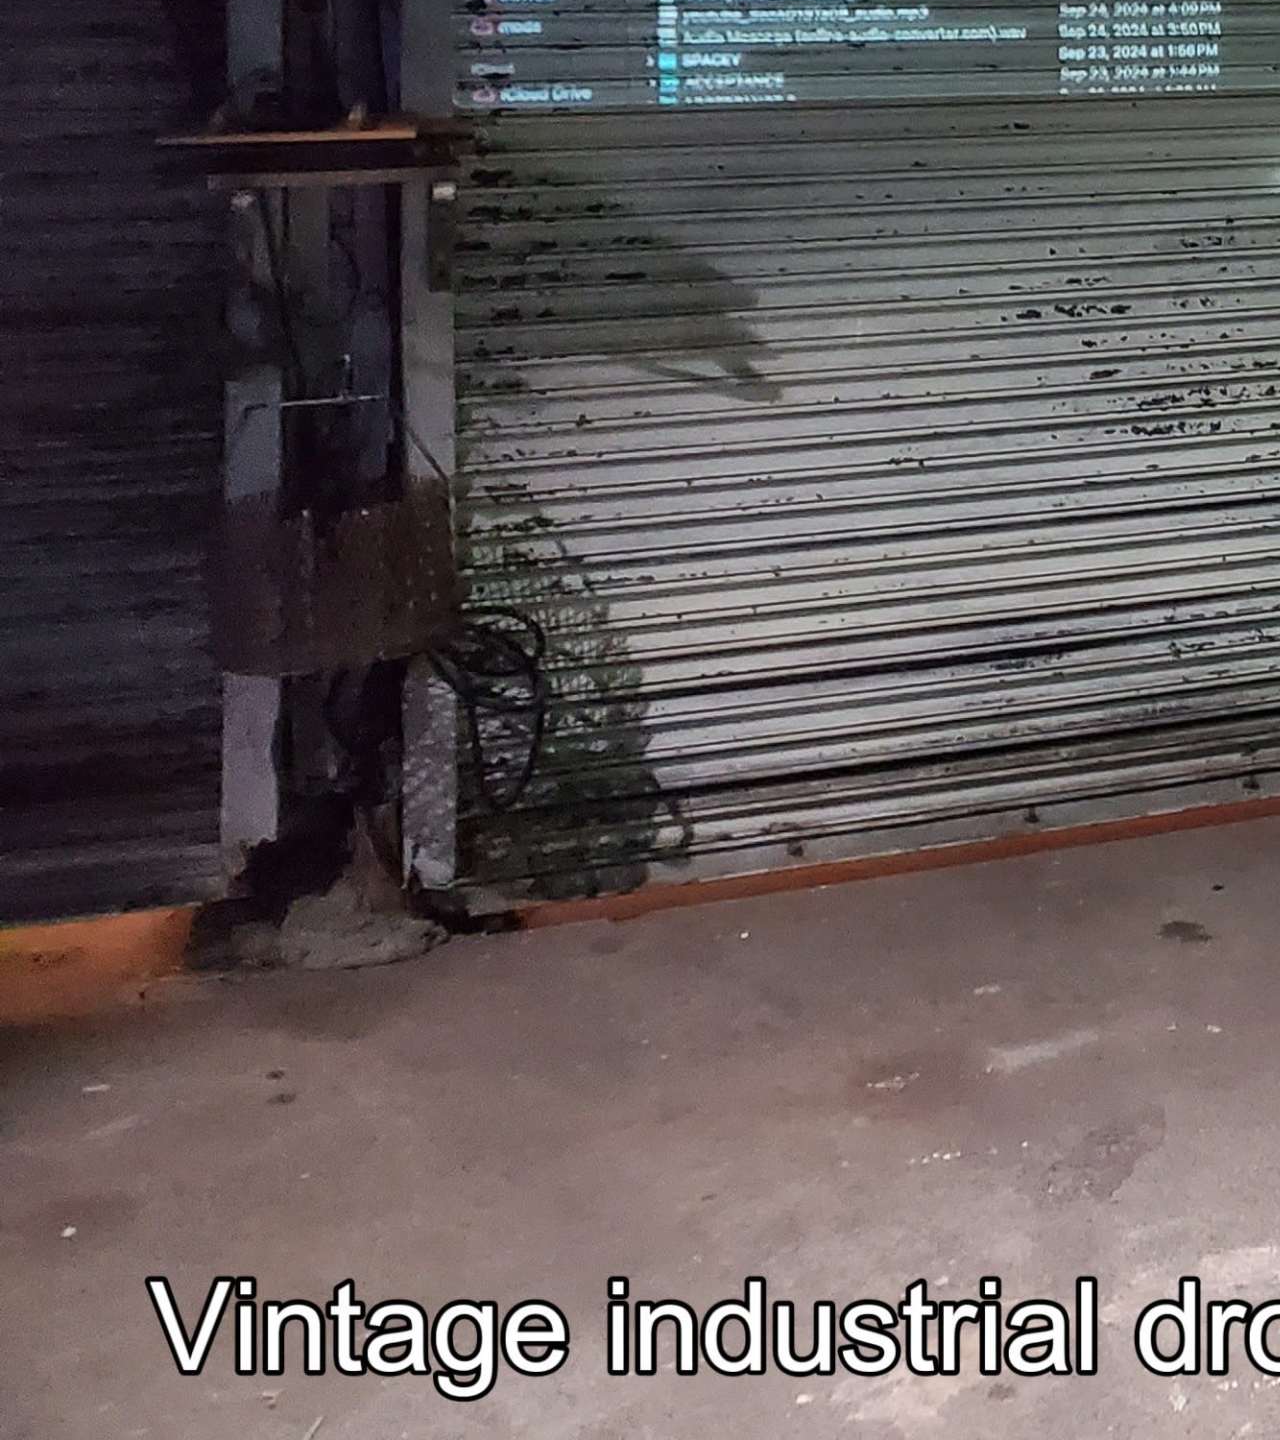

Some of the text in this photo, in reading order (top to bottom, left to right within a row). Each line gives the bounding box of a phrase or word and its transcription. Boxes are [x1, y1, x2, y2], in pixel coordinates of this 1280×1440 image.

[1112, 23, 1147, 37] 2024
[1058, 45, 1086, 61] Sep
[1112, 44, 1147, 59] 2024
[1150, 44, 1163, 58] at
[1197, 43, 1218, 57] PM
